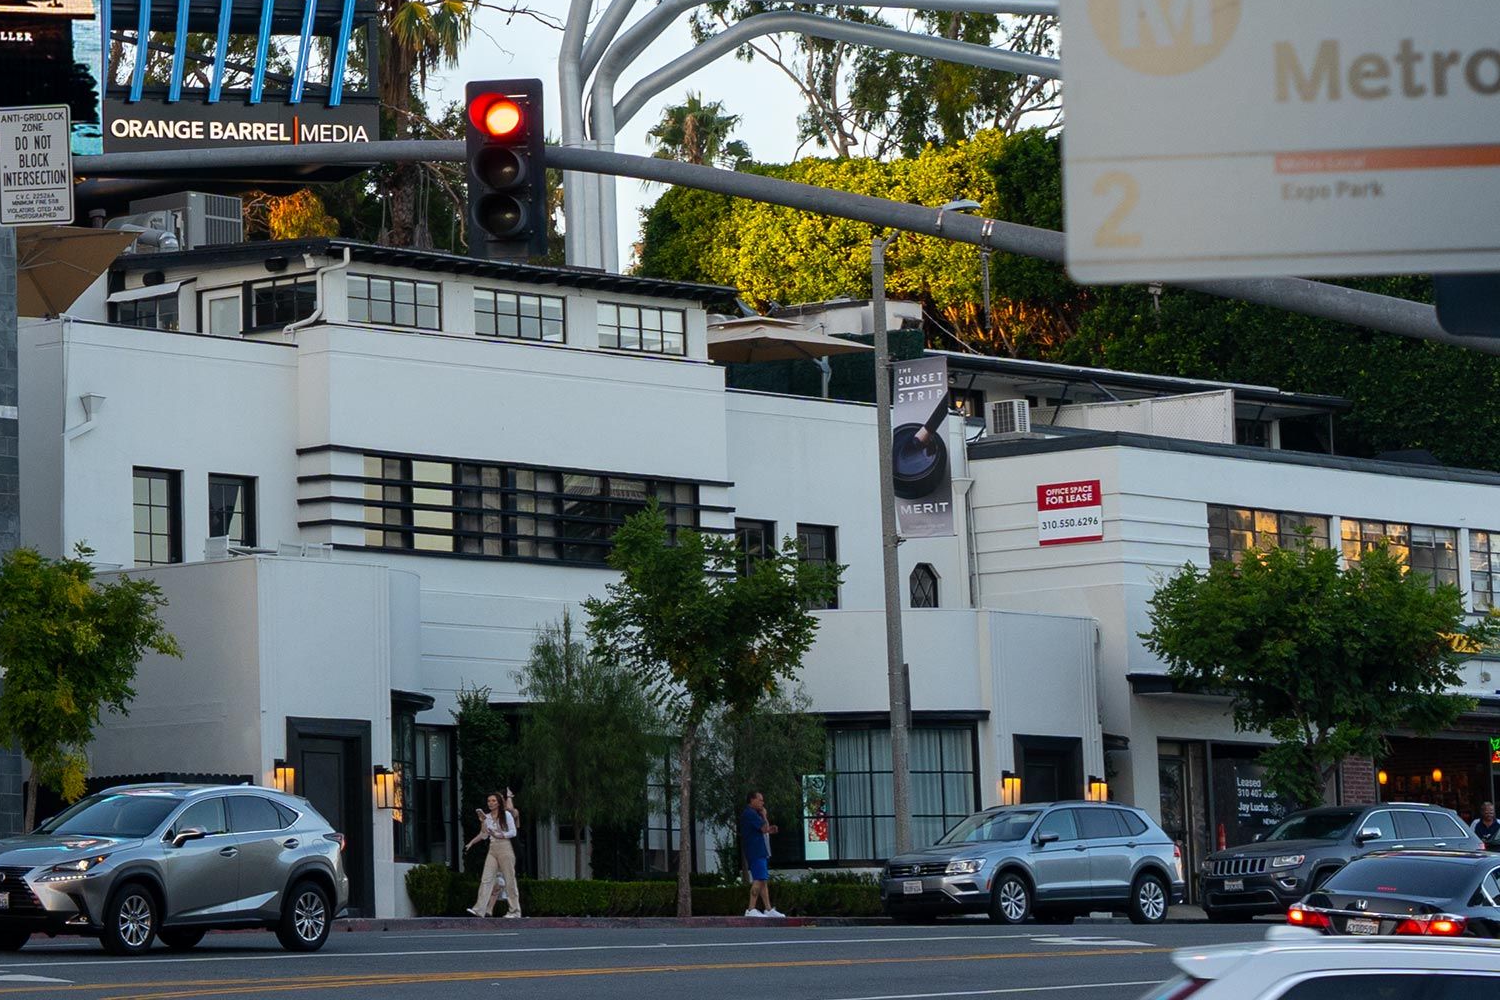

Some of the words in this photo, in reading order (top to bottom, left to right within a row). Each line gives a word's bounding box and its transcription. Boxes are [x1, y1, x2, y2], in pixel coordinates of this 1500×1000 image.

[1272, 36, 1500, 104] Metro
[0, 112, 65, 123] ANTI-GRIDLOCK
[22, 123, 44, 132] ZONE
[110, 118, 204, 140] ORANGE
[209, 121, 290, 142] BARREL
[301, 124, 369, 143] MEDIA
[15, 136, 28, 151] DO
[34, 135, 51, 149] NOT
[19, 153, 49, 168] BLOCK
[3, 170, 67, 187] INTERSECTION
[1092, 170, 1142, 250] 2
[898, 371, 943, 386] SUNSET
[898, 389, 943, 403] STRIP
[1045, 487, 1069, 496] OFFICE
[1070, 485, 1092, 493] SPACE
[1045, 496, 1064, 505] FOR
[1065, 493, 1092, 503] LEASE
[900, 502, 949, 515] MERIT
[1042, 516, 1098, 530] 310.550.6296
